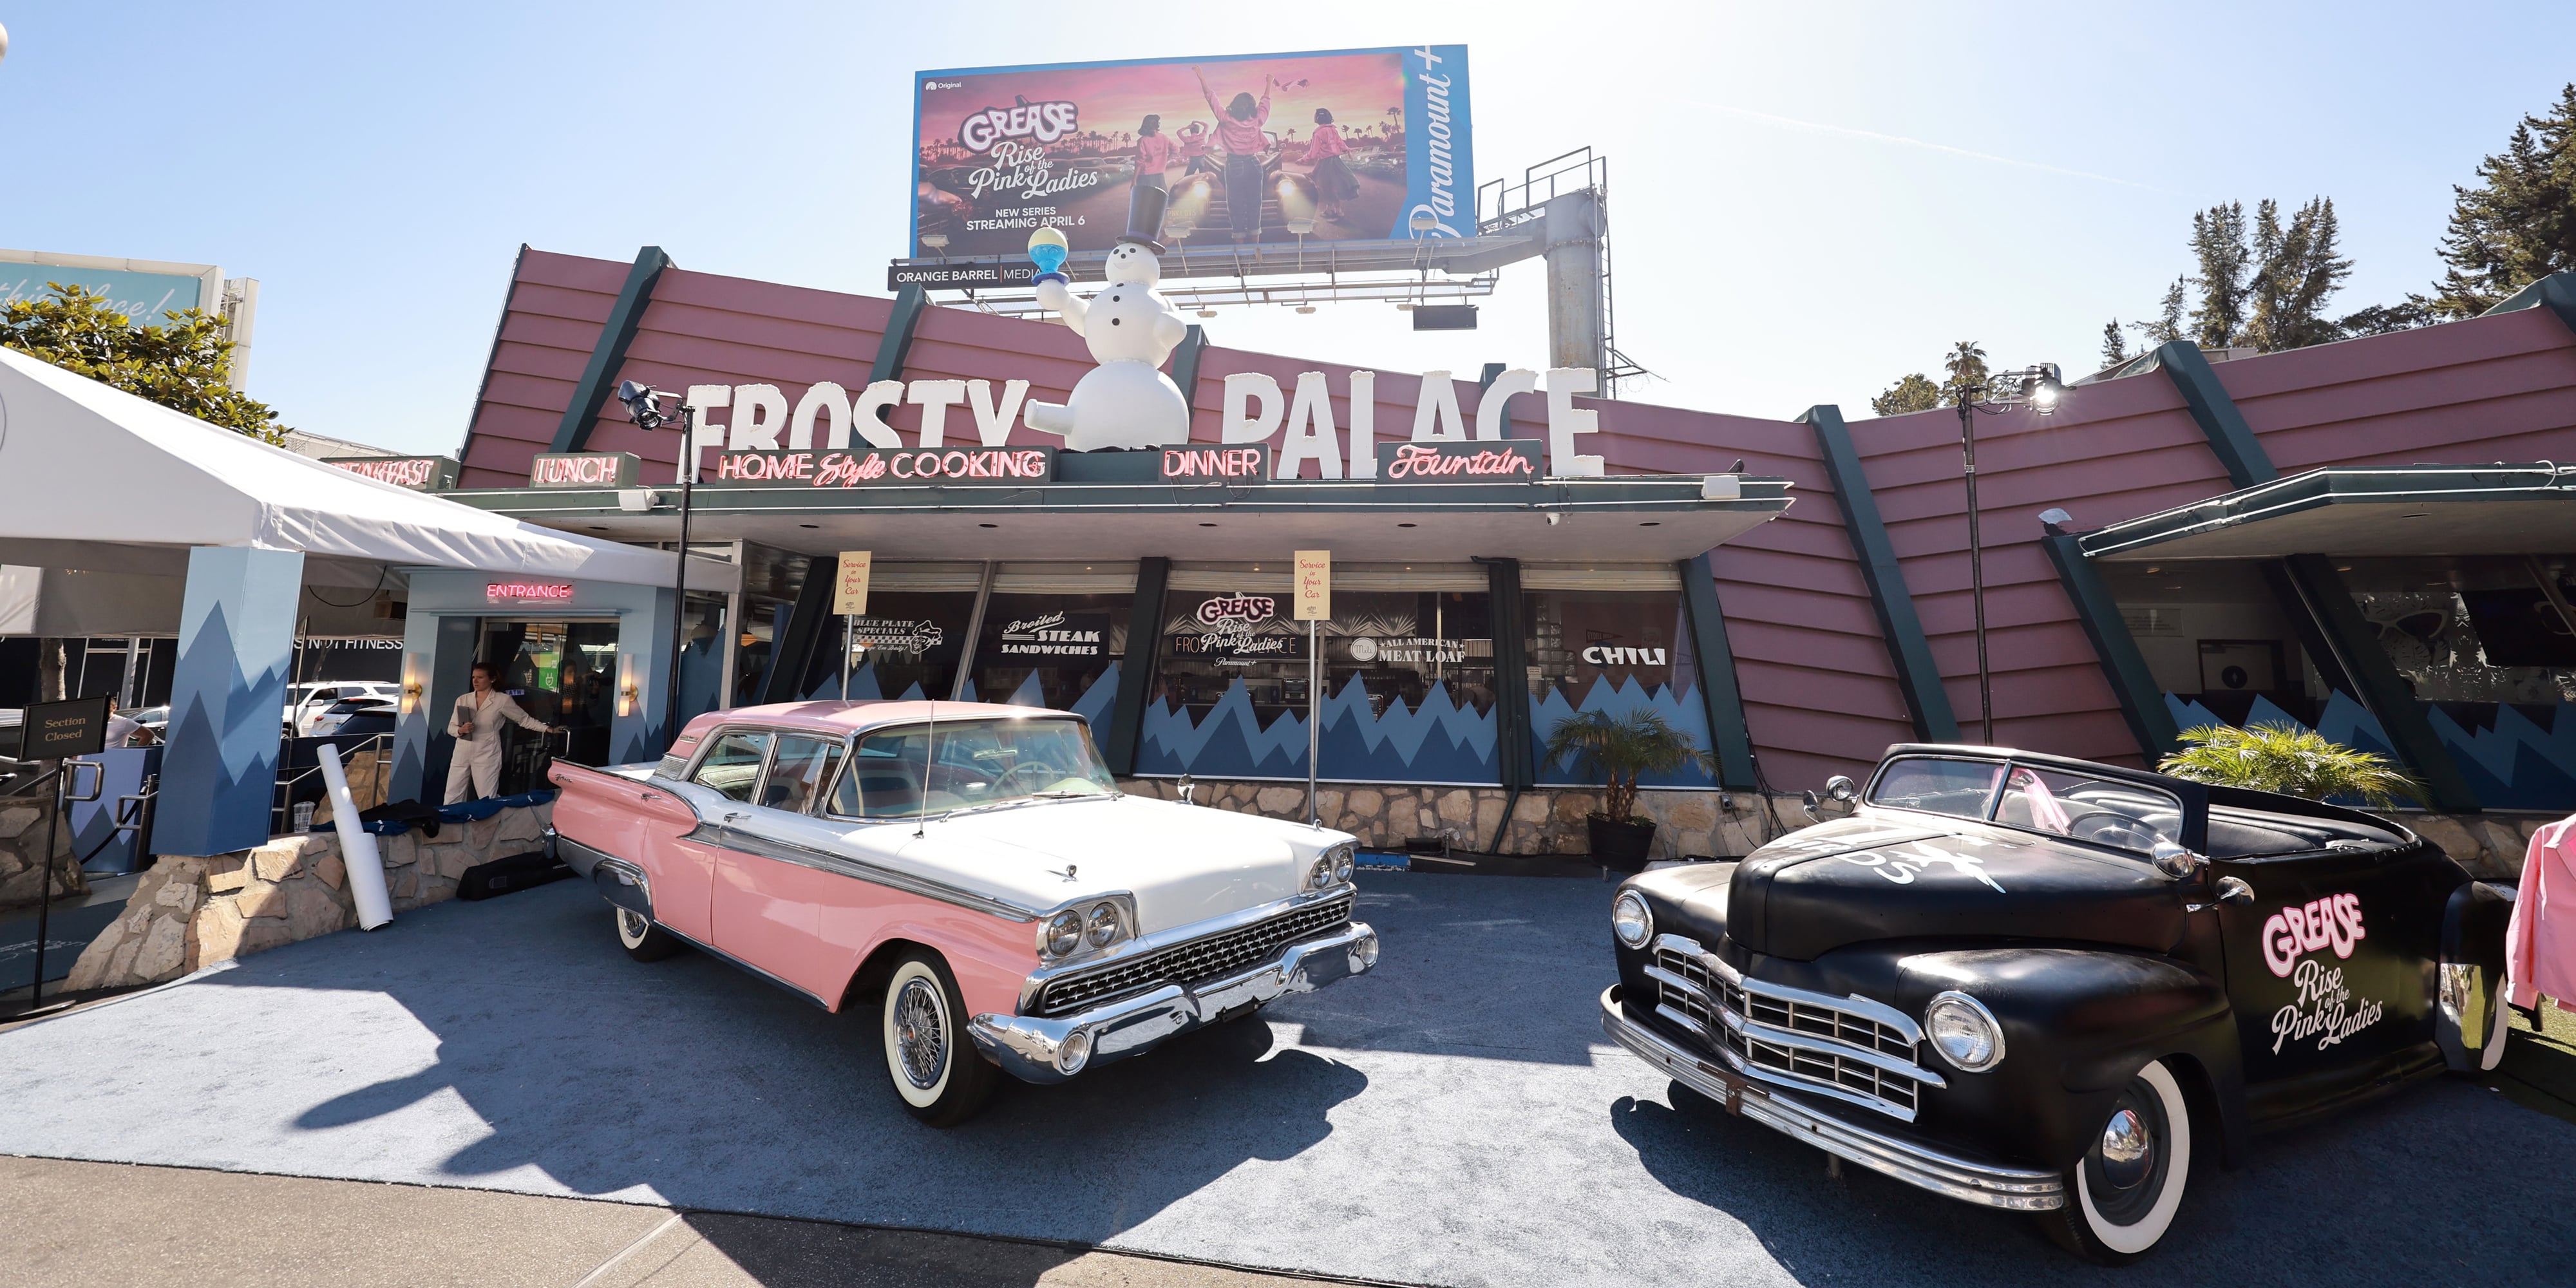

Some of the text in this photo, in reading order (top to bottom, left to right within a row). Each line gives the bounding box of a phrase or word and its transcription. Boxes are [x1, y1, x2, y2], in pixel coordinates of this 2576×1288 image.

[963, 102, 1077, 151] GREASE
[990, 141, 1045, 171] Rise
[1025, 158, 1054, 175] of the
[968, 165, 1097, 200] Pink Ladies
[996, 207, 1056, 218] NEW SERIES
[966, 215, 1086, 231] STREAMING APRIL 6
[896, 270, 949, 283] ORANGE
[951, 269, 998, 281] BARREL
[90, 283, 176, 321] lace!
[675, 366, 1605, 485] FROSTY PALACE
[719, 450, 1047, 489] HOME Style COOKING
[1164, 448, 1261, 478] DINNER
[1388, 444, 1536, 479] Fountain
[533, 457, 619, 484] LUNCH
[843, 559, 866, 568] Service
[1300, 559, 1326, 569] Service
[844, 574, 861, 587] Your
[1303, 576, 1321, 590] Your
[486, 583, 569, 598] ENTRANCE
[845, 587, 858, 595] Car
[1305, 589, 1320, 598] Car
[1200, 598, 1273, 623] GREASE
[1003, 611, 1065, 634] Broiled
[1217, 618, 1251, 636] Rise
[345, 639, 404, 650] FITNESS
[1037, 630, 1101, 643] STEAK
[1200, 633, 1283, 654] Pink Ladies
[1386, 638, 1459, 649] ALL AMERICAN
[1001, 644, 1098, 655] SANDWICHES
[1379, 650, 1466, 663] MEAT LOAF
[1582, 646, 1666, 665] CHILI
[1214, 656, 1257, 667] Paramount+
[44, 717, 87, 729] Section
[44, 728, 83, 742] Closed
[2262, 893, 2366, 978] GREASE
[2294, 959, 2344, 1009] Rise
[2324, 985, 2351, 1012] of the
[2271, 996, 2383, 1056] Pink Ladies
